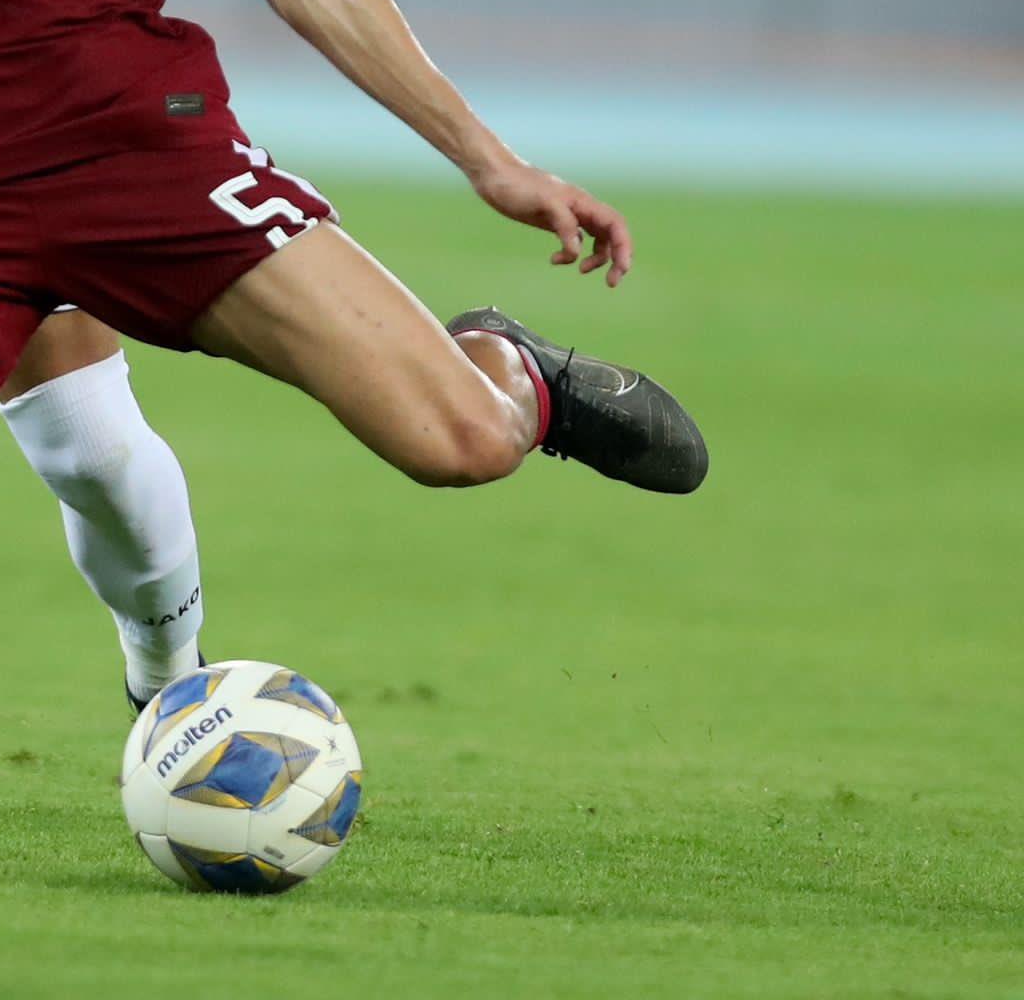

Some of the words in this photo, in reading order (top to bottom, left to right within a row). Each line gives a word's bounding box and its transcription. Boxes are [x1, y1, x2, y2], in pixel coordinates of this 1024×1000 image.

[208, 171, 320, 249] 5
[142, 586, 199, 627] JAKO
[157, 707, 233, 778] molten
